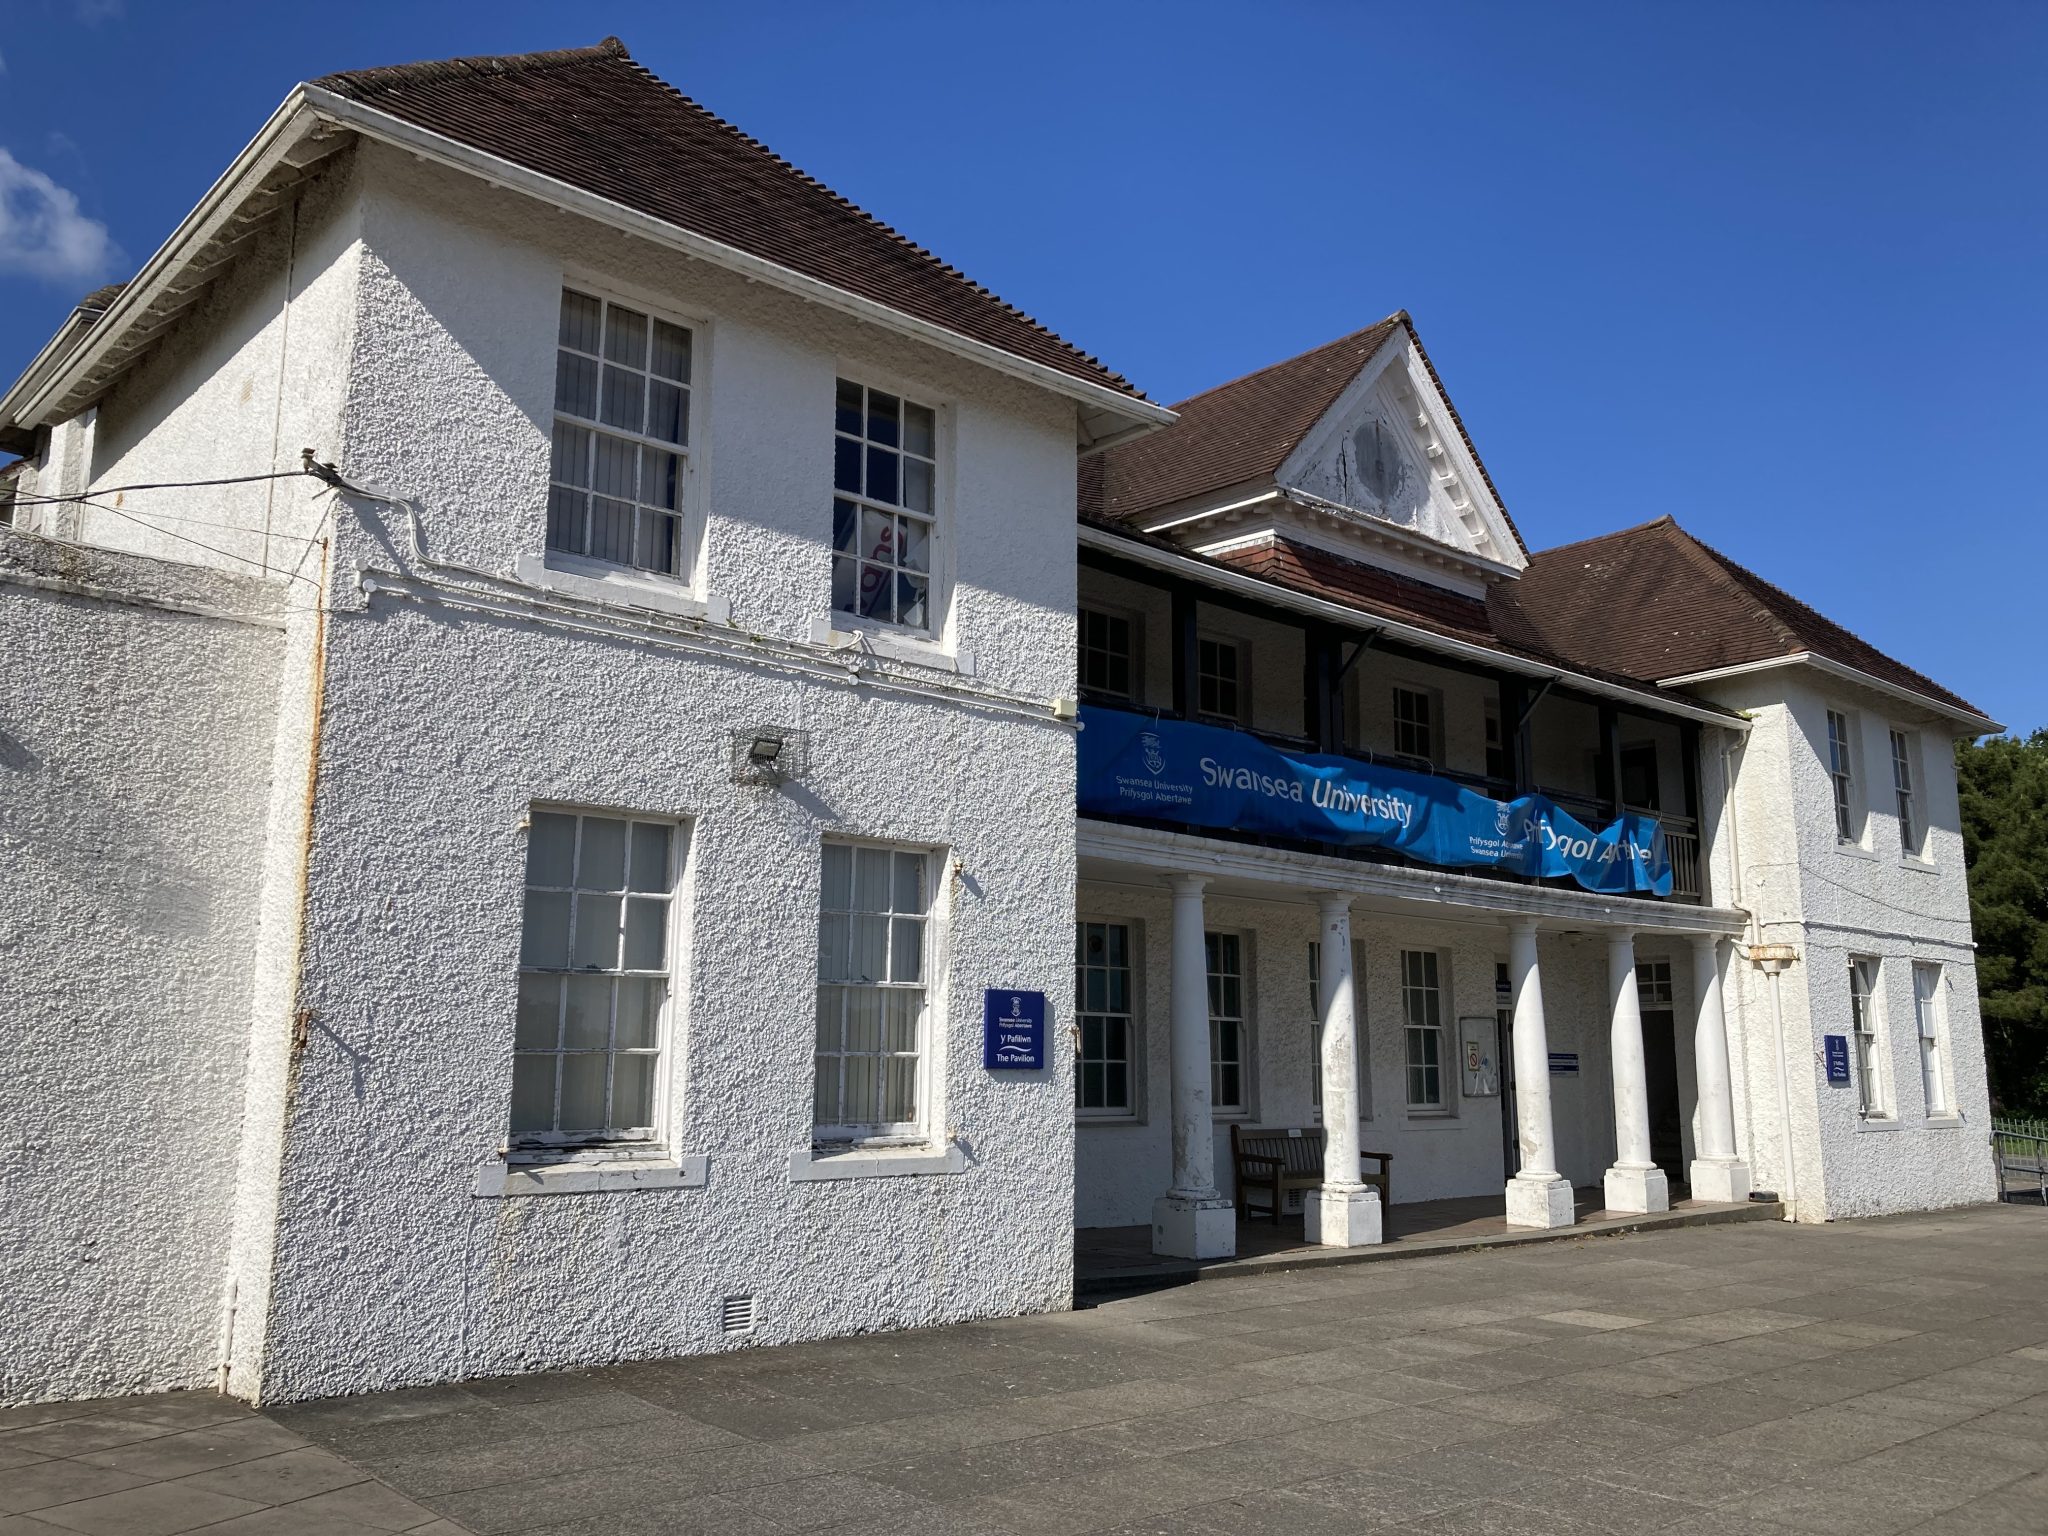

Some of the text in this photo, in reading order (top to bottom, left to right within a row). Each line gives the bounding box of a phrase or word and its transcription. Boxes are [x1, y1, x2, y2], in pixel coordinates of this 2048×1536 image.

[1116, 775, 1192, 794] Swansea University
[1199, 757, 1413, 829] Swansea University
[1119, 787, 1192, 805] Prifysgol Abertawe
[996, 1054, 1035, 1062] The Pavilion
